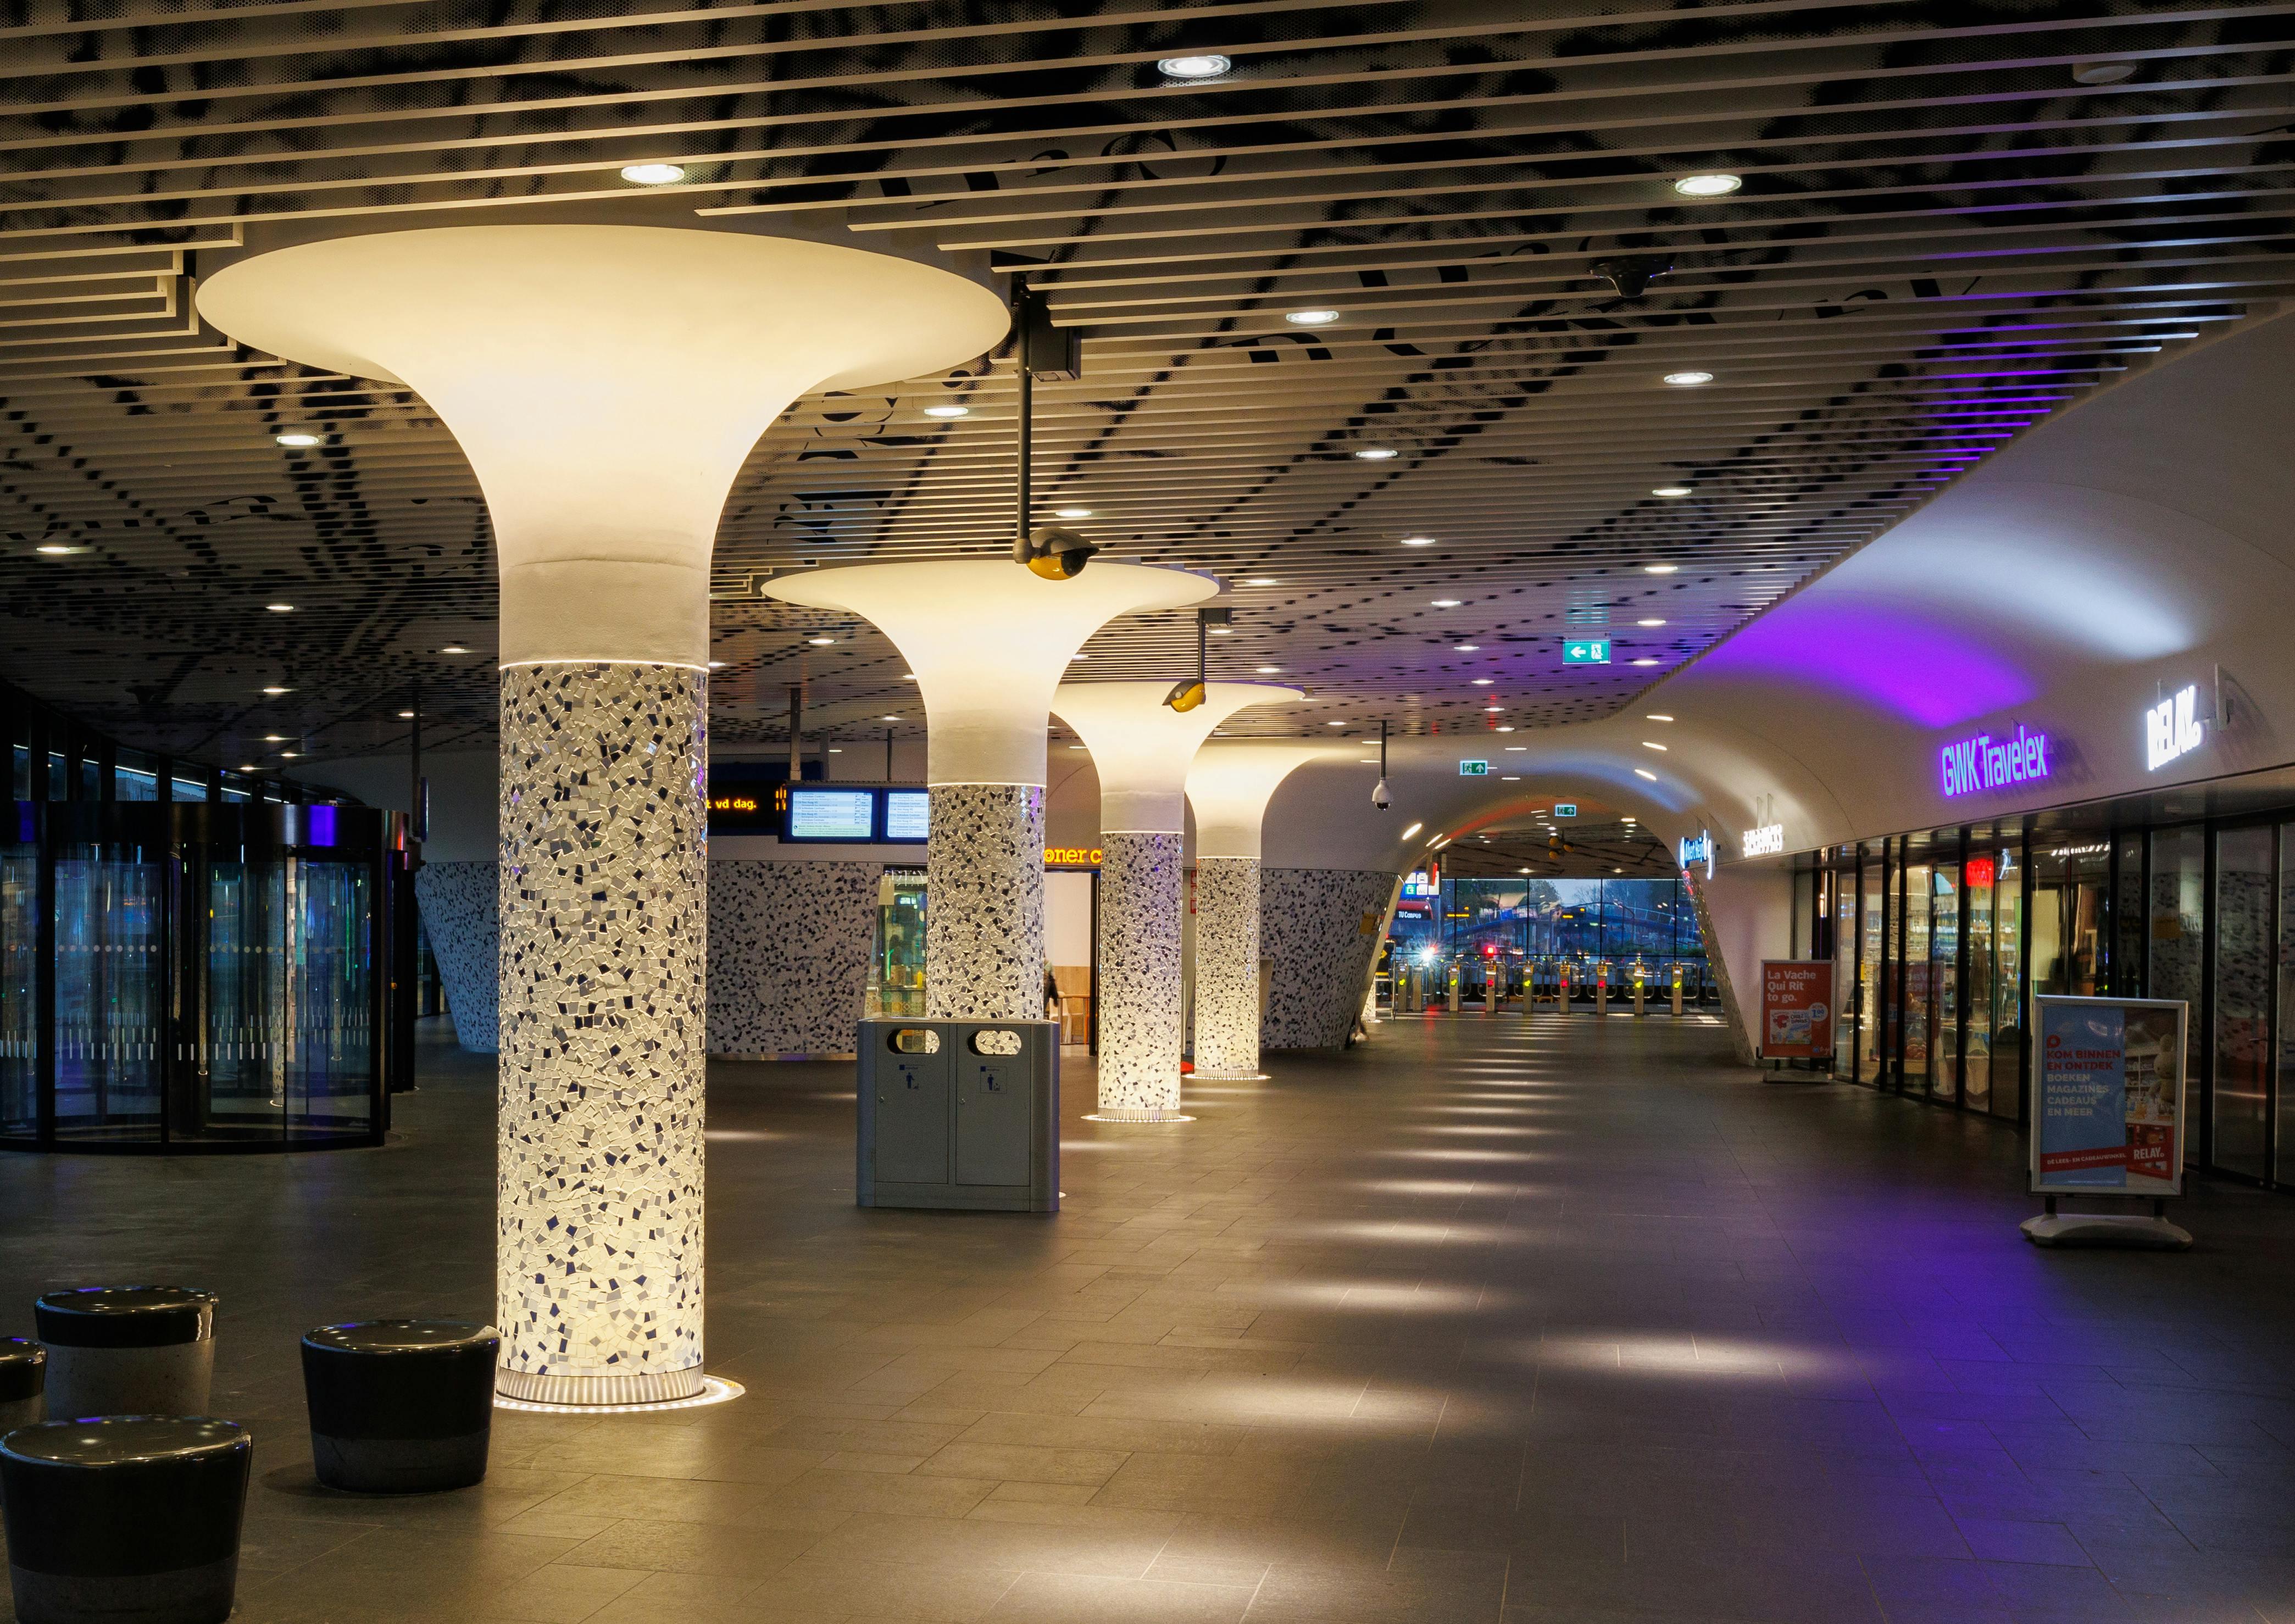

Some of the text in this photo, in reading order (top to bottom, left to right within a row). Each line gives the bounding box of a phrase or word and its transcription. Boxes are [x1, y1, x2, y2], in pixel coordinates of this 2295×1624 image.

[1942, 725, 2048, 796] GWK Travelex
[715, 799, 729, 808] vd
[733, 799, 757, 810] dag.
[1685, 841, 1696, 861] Albert
[1768, 970, 1816, 980] La Vache
[1768, 981, 1804, 992] Qui Rit
[1768, 993, 1797, 1003] to go.
[2047, 1050, 2121, 1059] KOM BINNEN
[2047, 1061, 2114, 1070] EN ONTDEK
[2047, 1074, 2090, 1082] BOEKEN
[2047, 1084, 2109, 1093] MAGAZINES
[2047, 1096, 2097, 1105] CADEAUS
[2047, 1108, 2093, 1116] EN MEER
[2081, 1153, 2126, 1163] CADEAUWINKEL
[2133, 1147, 2161, 1160] RELAY
